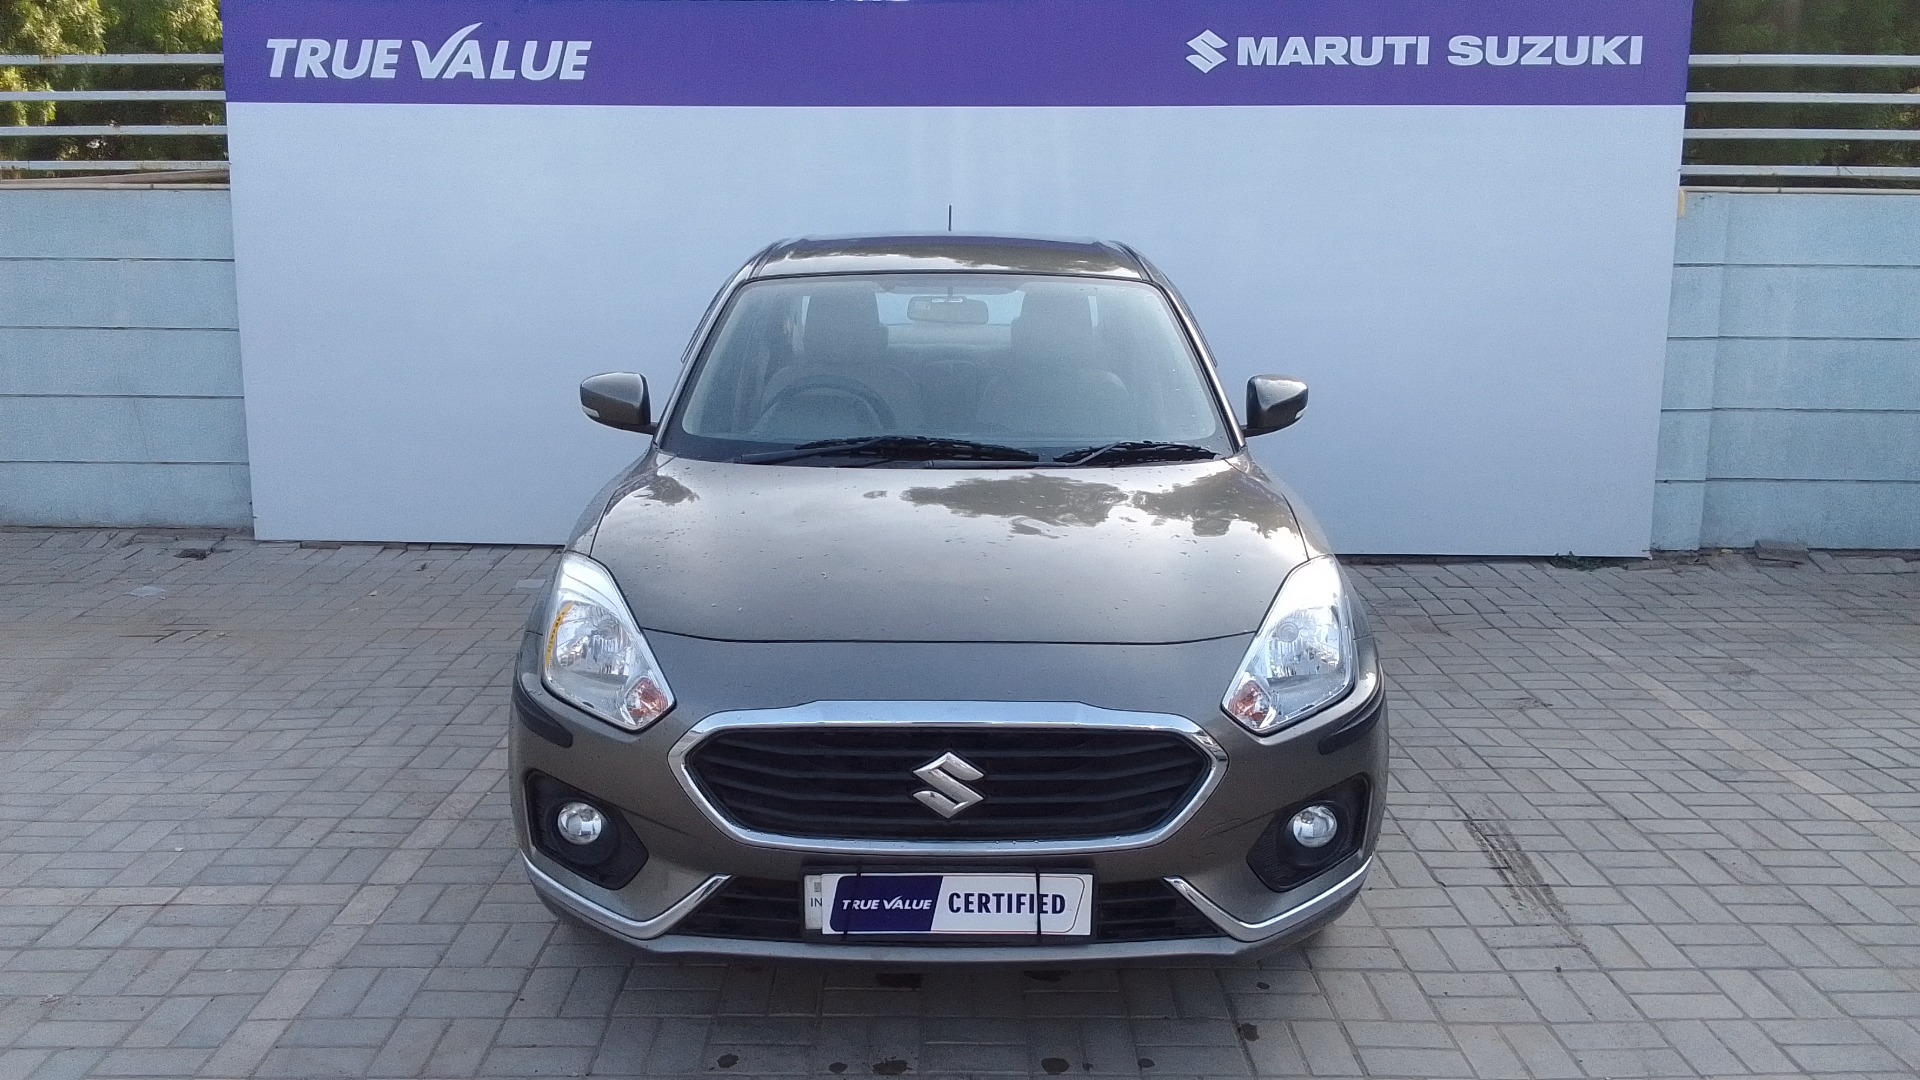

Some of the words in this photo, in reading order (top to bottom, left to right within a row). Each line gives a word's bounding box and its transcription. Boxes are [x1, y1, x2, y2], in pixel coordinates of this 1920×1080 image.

[266, 38, 402, 79] TRUE
[411, 22, 592, 81] VALUE
[1237, 35, 1430, 66] MARUTI
[1447, 35, 1644, 66] SUZUKI
[810, 897, 823, 908] IN
[842, 899, 880, 910] TRUE
[882, 895, 933, 910] VALUE
[947, 892, 1066, 914] CERTIFIED
